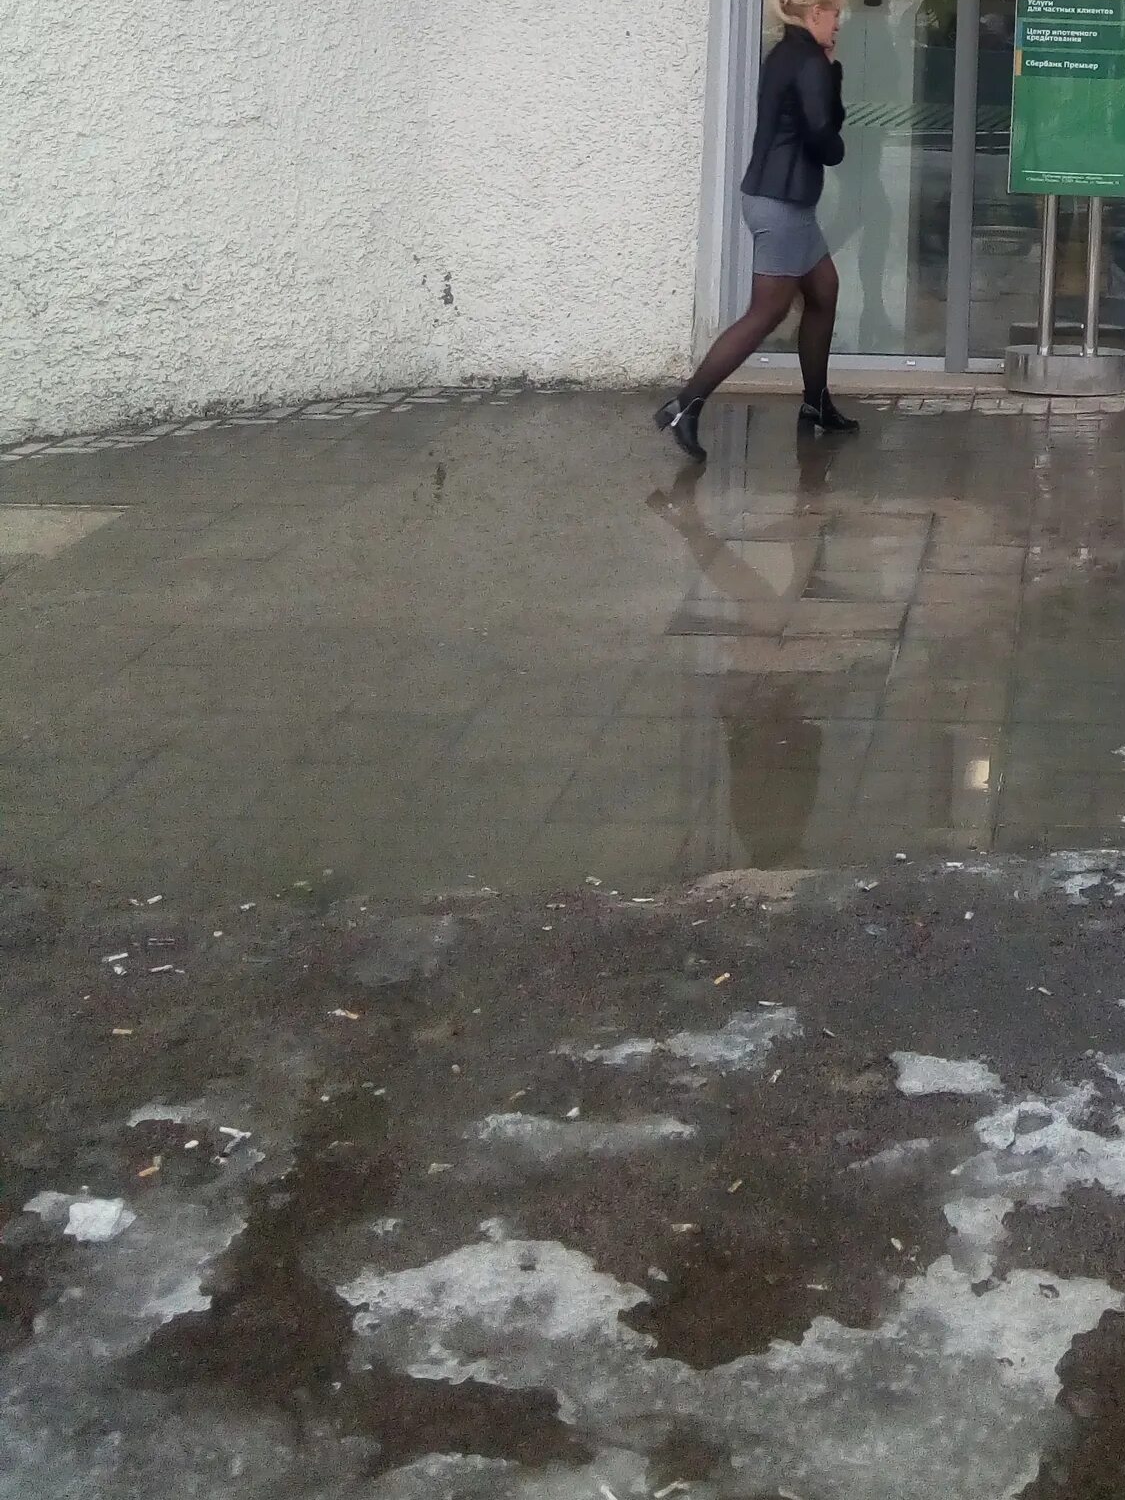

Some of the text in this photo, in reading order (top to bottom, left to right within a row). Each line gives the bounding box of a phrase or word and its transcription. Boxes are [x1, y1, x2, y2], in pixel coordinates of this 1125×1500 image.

[1027, 0, 1054, 7] Услуги
[1043, 6, 1075, 14] частных
[1076, 7, 1114, 15] клиентов
[1026, 27, 1098, 38] Центр ипотечного
[1026, 35, 1082, 43] кредитования
[1025, 59, 1099, 71] Сбербанк Премьер
